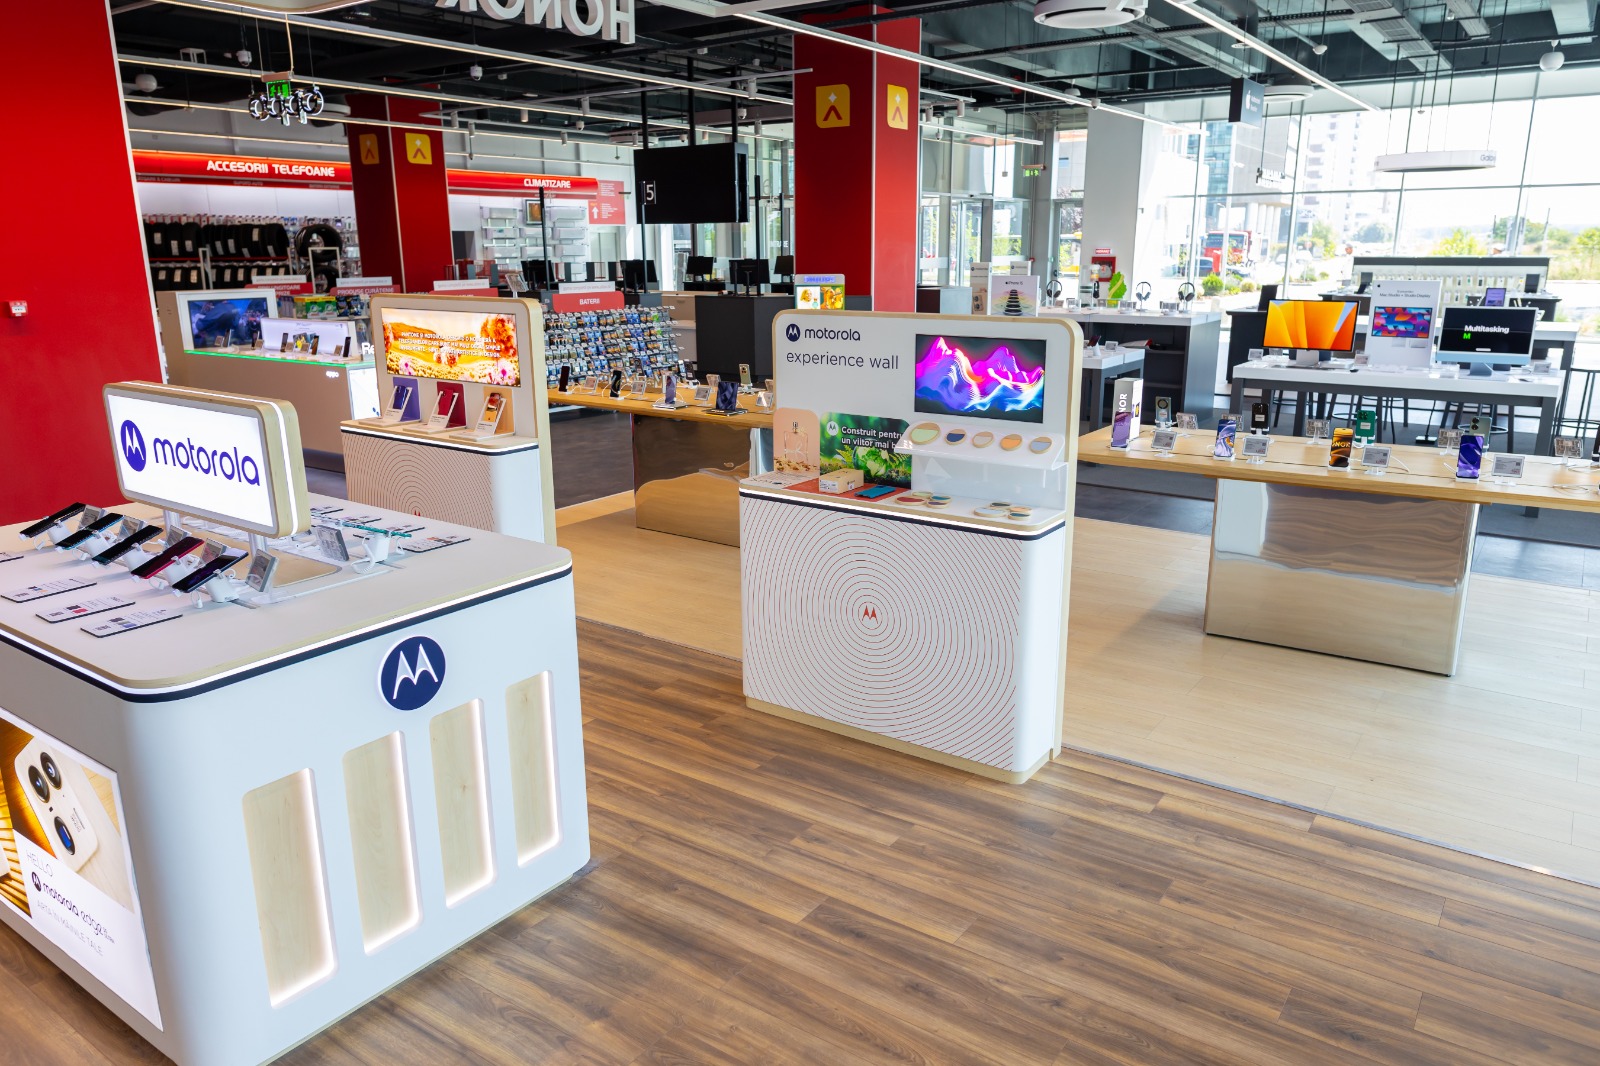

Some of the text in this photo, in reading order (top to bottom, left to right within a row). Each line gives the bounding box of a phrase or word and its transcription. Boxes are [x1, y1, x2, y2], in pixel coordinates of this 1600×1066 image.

[206, 160, 336, 177] ACCESORII TELEFOANE
[523, 178, 571, 189] CLIMATIZARE
[646, 184, 654, 201] 5
[804, 327, 861, 341] motorola
[1463, 332, 1471, 340] M
[1464, 324, 1510, 335] Multitasking
[786, 351, 899, 369] experience wall
[841, 426, 877, 437] Construit
[841, 437, 851, 445] un
[852, 438, 874, 448] viitor
[874, 440, 890, 449] mai
[153, 437, 261, 487] motorola
[42, 882, 80, 917] motorola
[80, 910, 104, 936] edge
